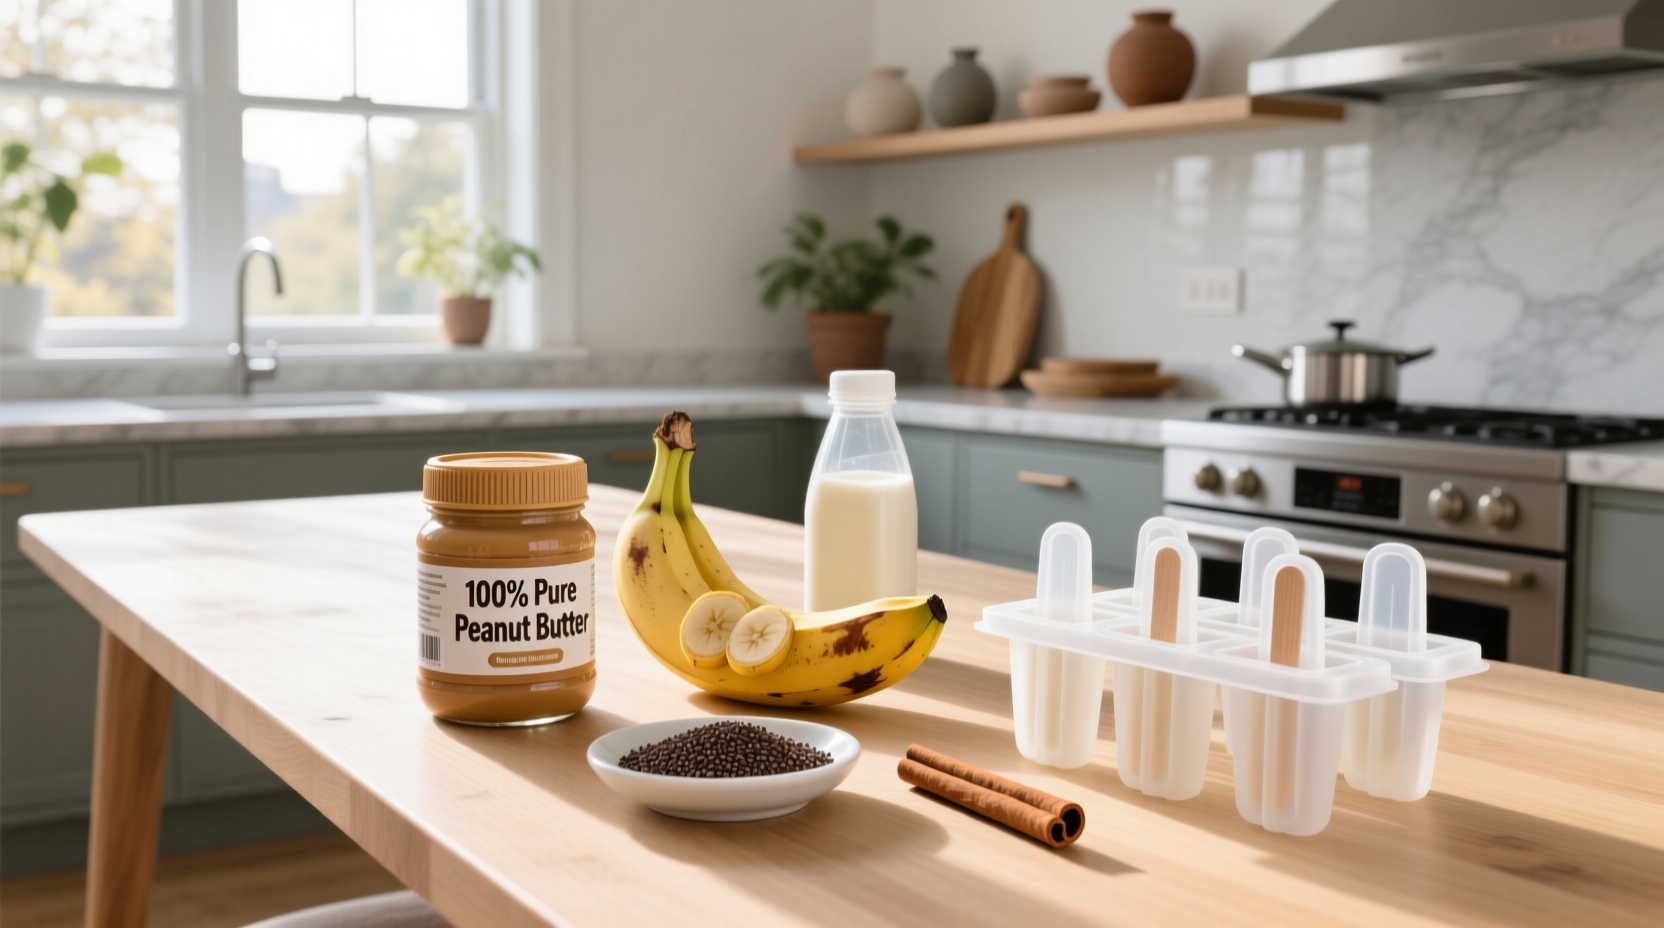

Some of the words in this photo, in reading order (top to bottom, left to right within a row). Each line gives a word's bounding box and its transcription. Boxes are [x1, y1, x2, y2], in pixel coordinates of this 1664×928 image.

[464, 578, 529, 608] 100%
[534, 578, 577, 606] Pure
[455, 613, 531, 643] Peanut
[536, 610, 589, 641] Butter
